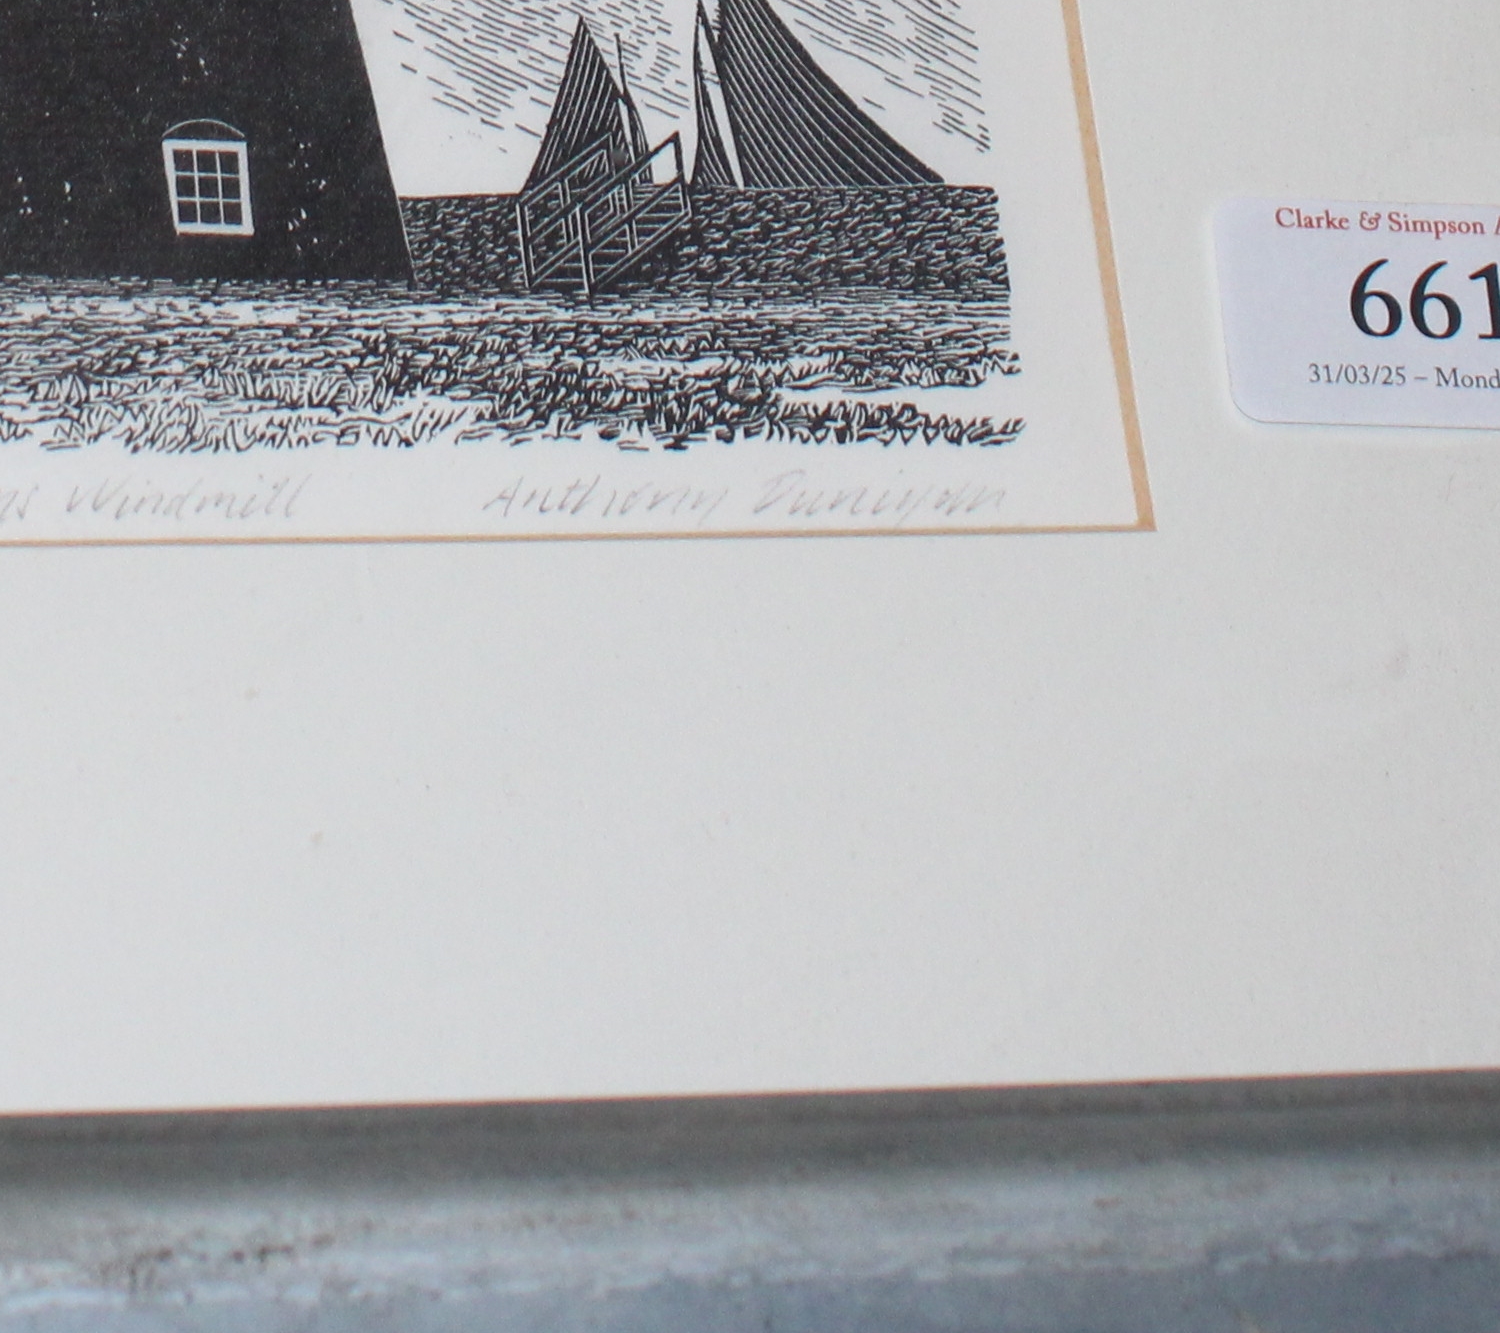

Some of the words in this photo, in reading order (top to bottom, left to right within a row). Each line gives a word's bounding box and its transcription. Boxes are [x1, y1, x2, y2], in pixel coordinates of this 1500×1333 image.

[1274, 206, 1351, 232] Clarke
[1358, 212, 1382, 232] &
[1387, 212, 1486, 240] Simpson
[1307, 362, 1408, 387] 31/03/25
[65, 472, 313, 521] Windmill
